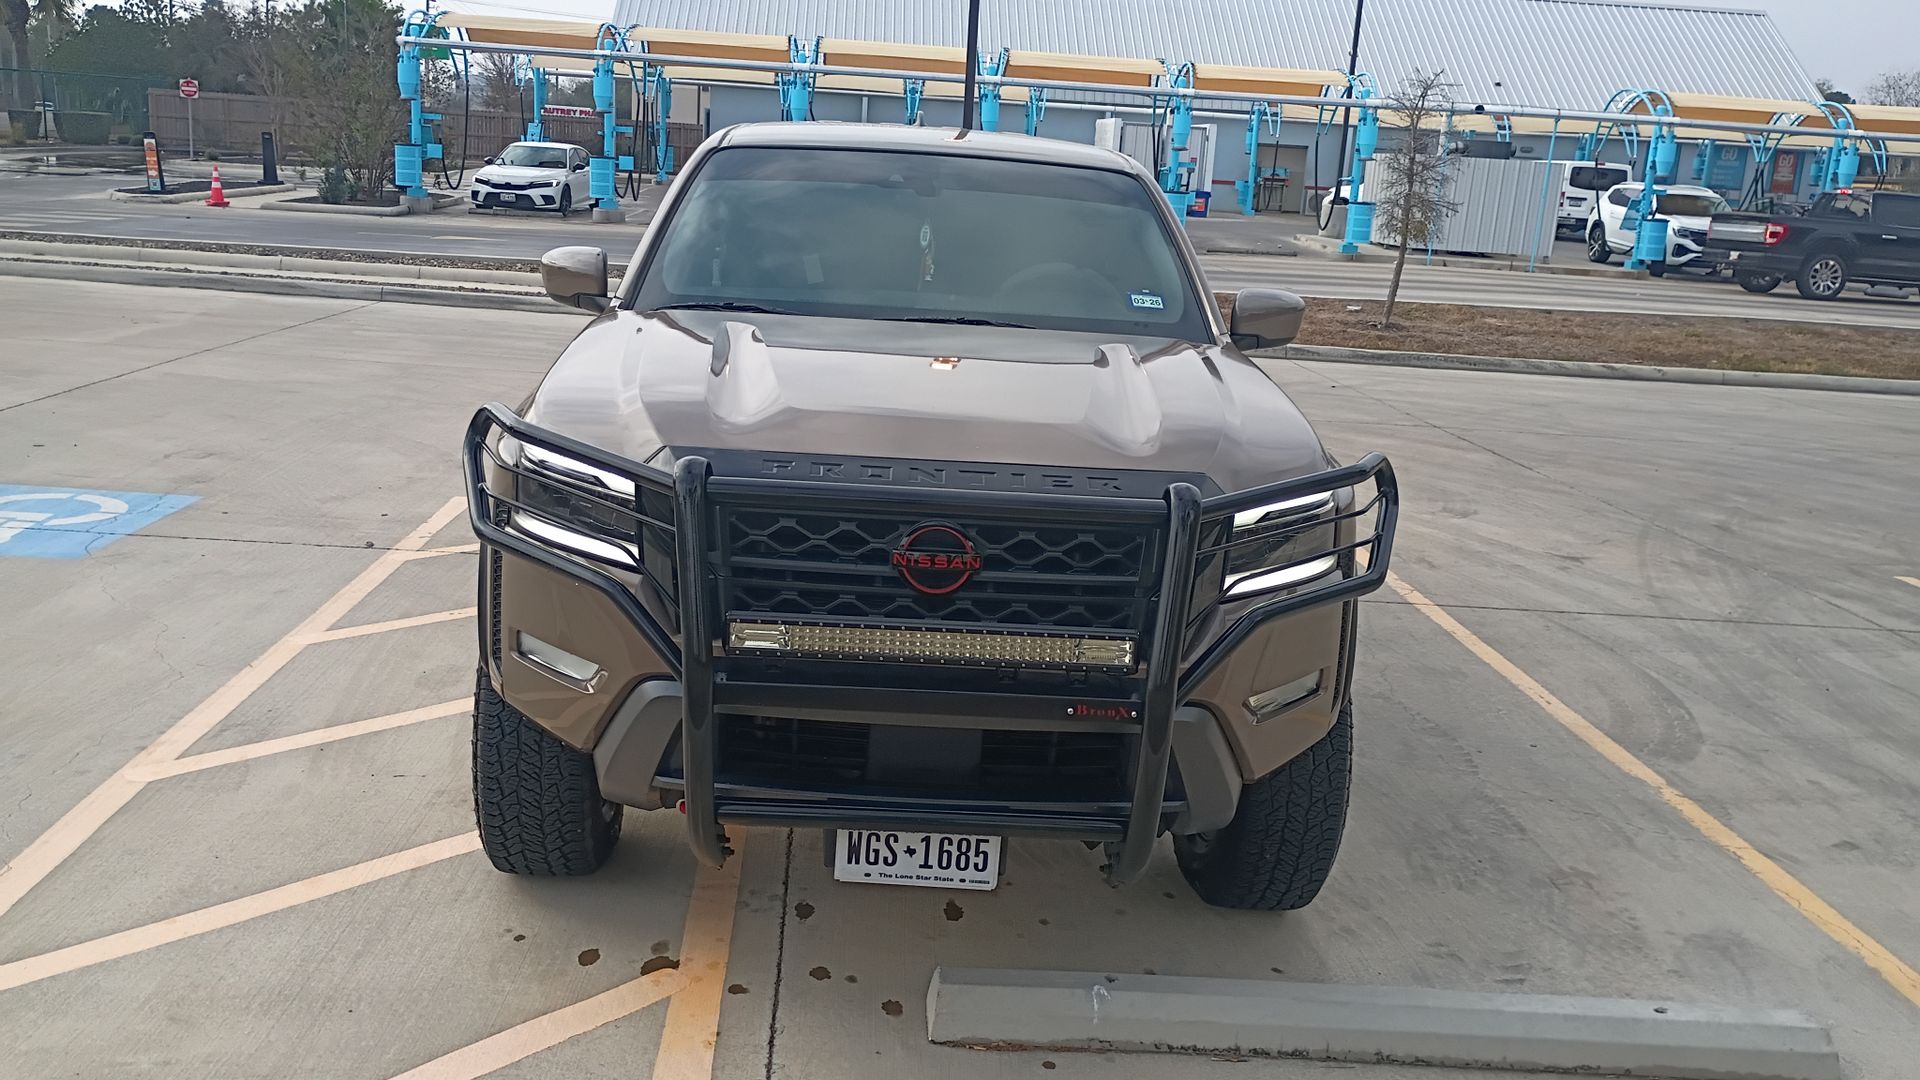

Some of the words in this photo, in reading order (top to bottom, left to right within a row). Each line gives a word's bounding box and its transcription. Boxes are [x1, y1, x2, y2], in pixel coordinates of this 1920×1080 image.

[543, 107, 578, 116] AUTREY
[1721, 147, 1738, 160] GO
[1778, 154, 1794, 167] GO
[761, 459, 1123, 491] FRONTIER
[892, 553, 980, 568] NISSAN
[847, 831, 899, 867] WGS
[918, 835, 990, 872] 1685
